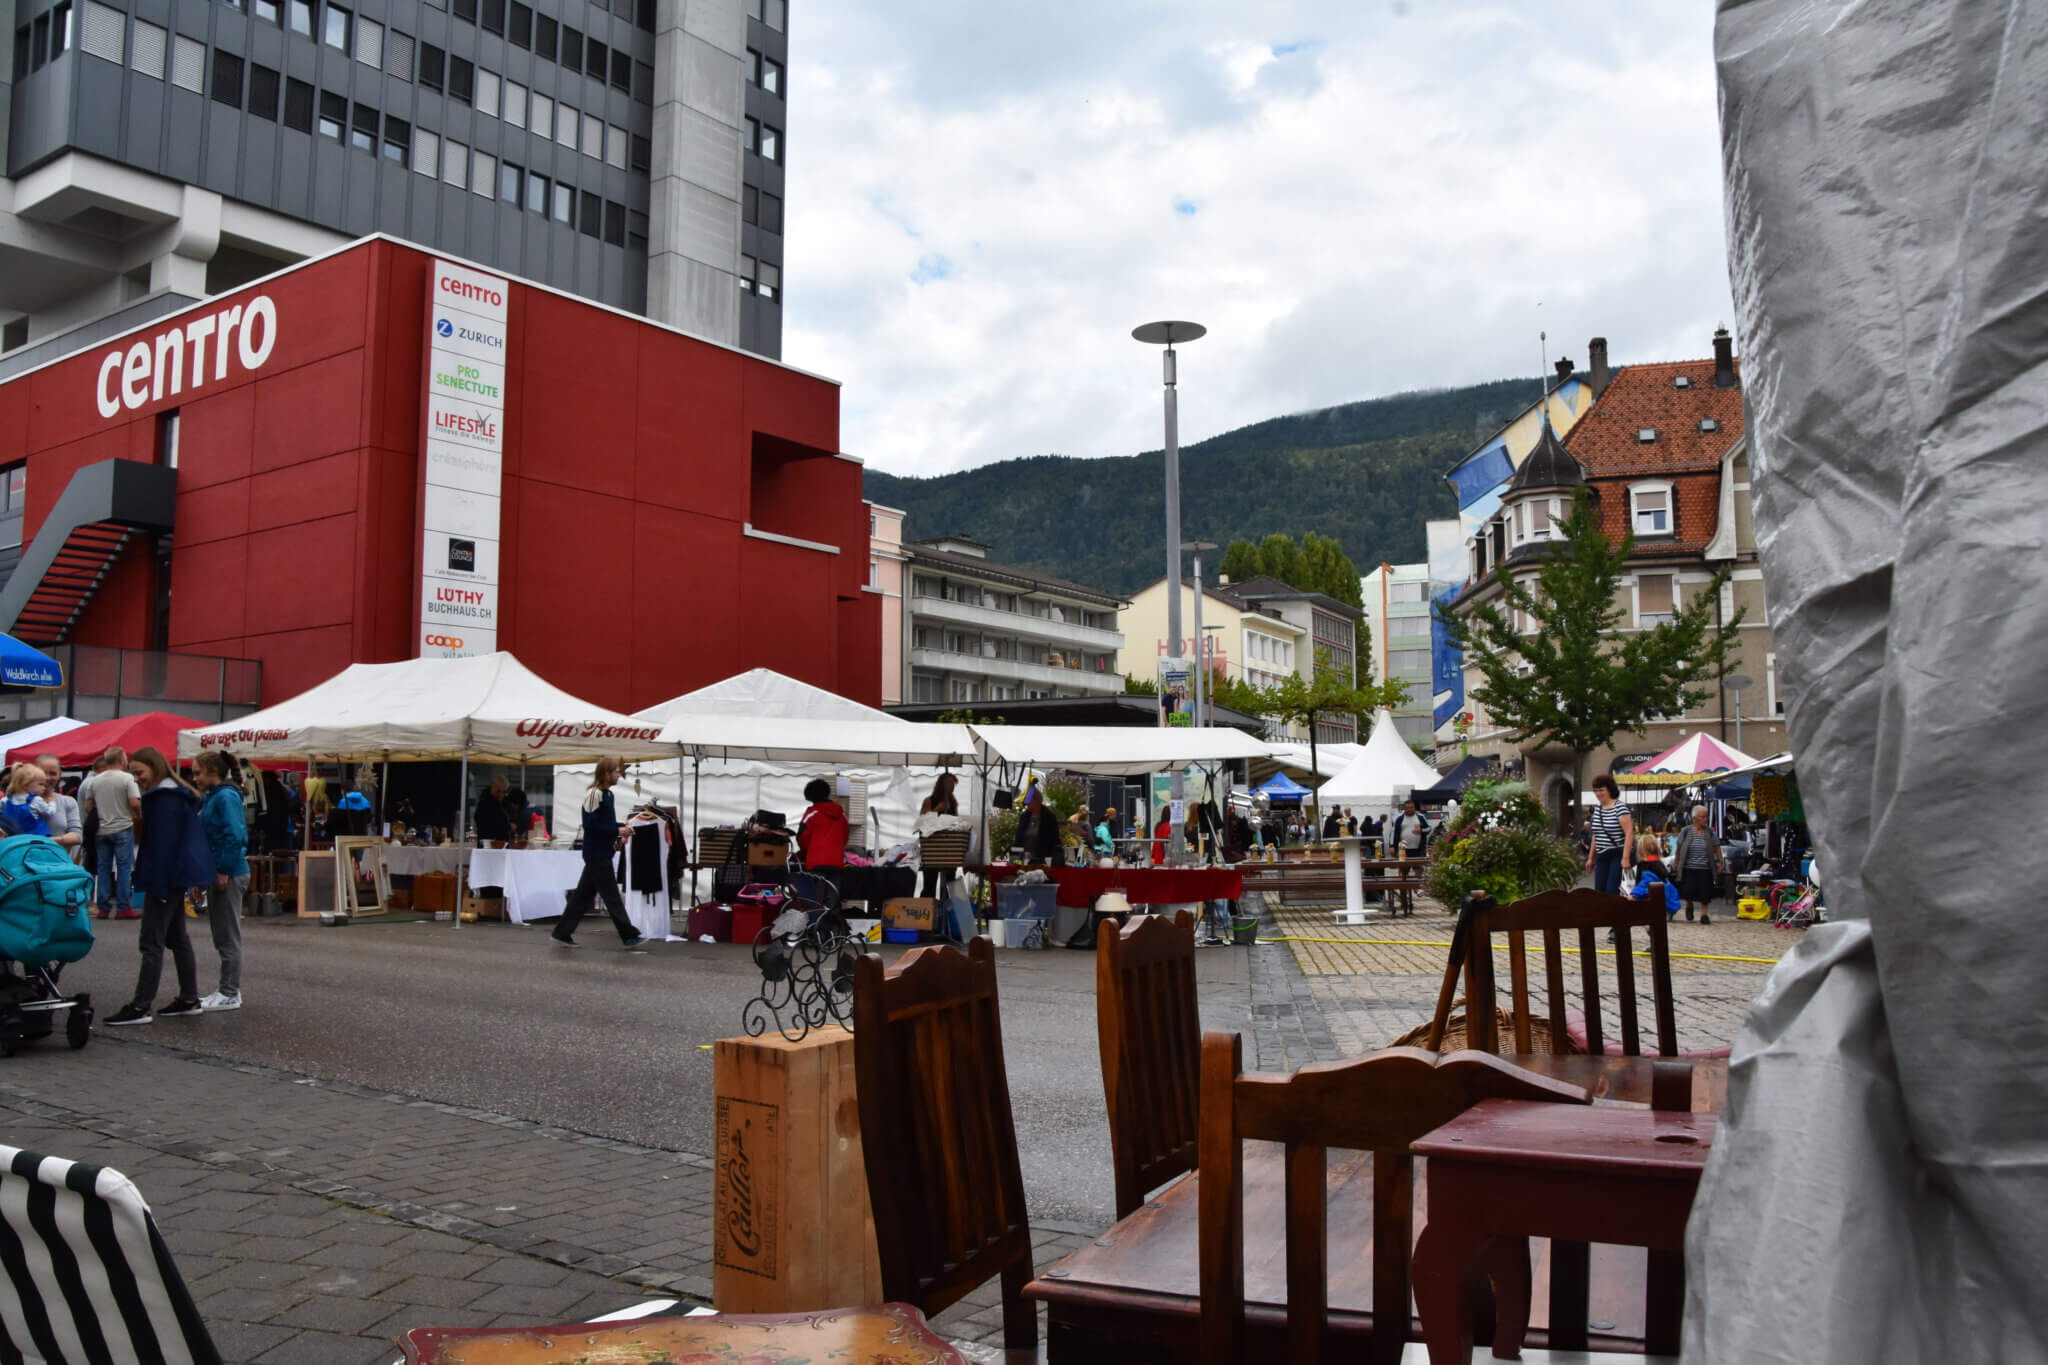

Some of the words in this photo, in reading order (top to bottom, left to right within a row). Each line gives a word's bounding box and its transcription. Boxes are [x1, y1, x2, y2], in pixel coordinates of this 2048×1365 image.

[459, 328, 503, 349] ZURICH
[457, 364, 480, 380] PRO
[436, 373, 499, 398] SENECTUTE
[437, 587, 484, 605] LÜTHY
[428, 602, 492, 619] BUCHHAUS.CH
[425, 634, 464, 651] coop
[201, 732, 237, 748] garage
[253, 728, 290, 748] palais
[516, 718, 577, 749] Alfa
[580, 720, 663, 740] Romeo
